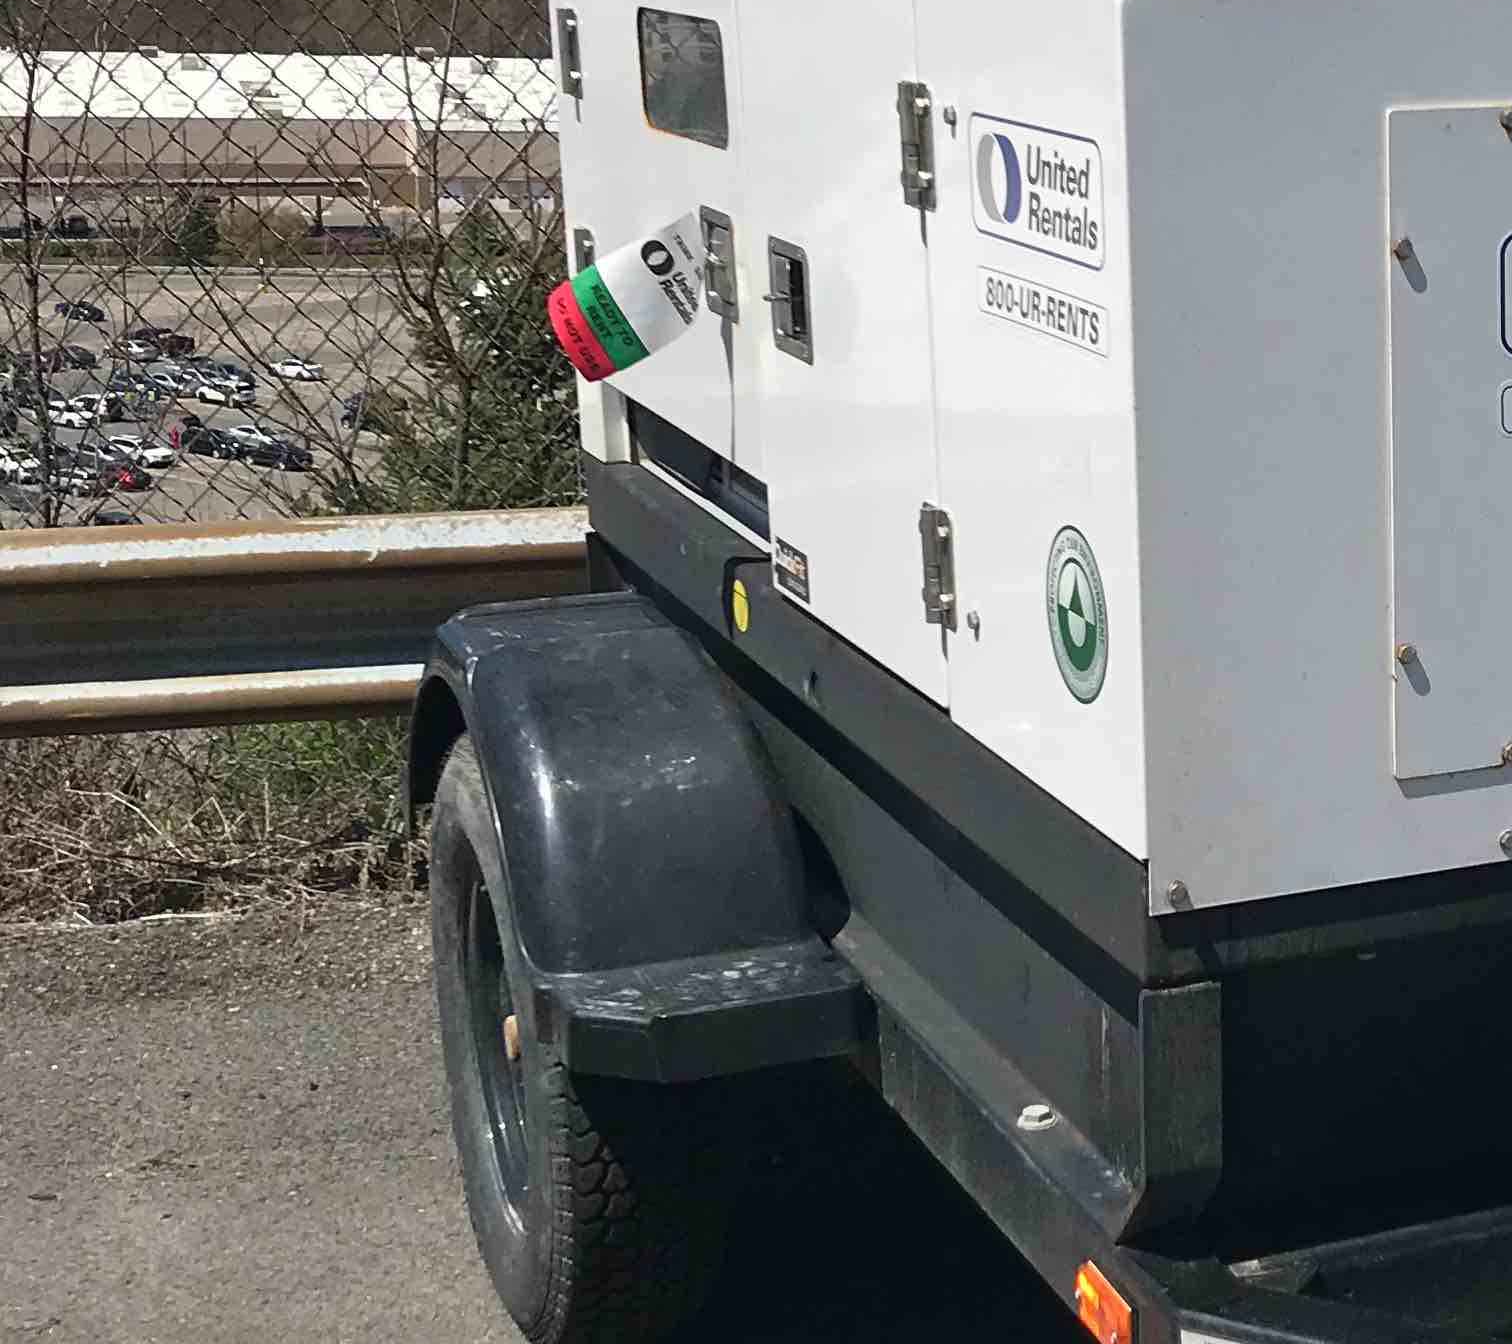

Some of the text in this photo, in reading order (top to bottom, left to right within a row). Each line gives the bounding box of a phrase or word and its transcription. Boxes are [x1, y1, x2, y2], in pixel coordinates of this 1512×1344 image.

[1026, 144, 1090, 199] United
[1028, 191, 1098, 250] Rentals
[986, 276, 1100, 345] 800-UR-RENTS
